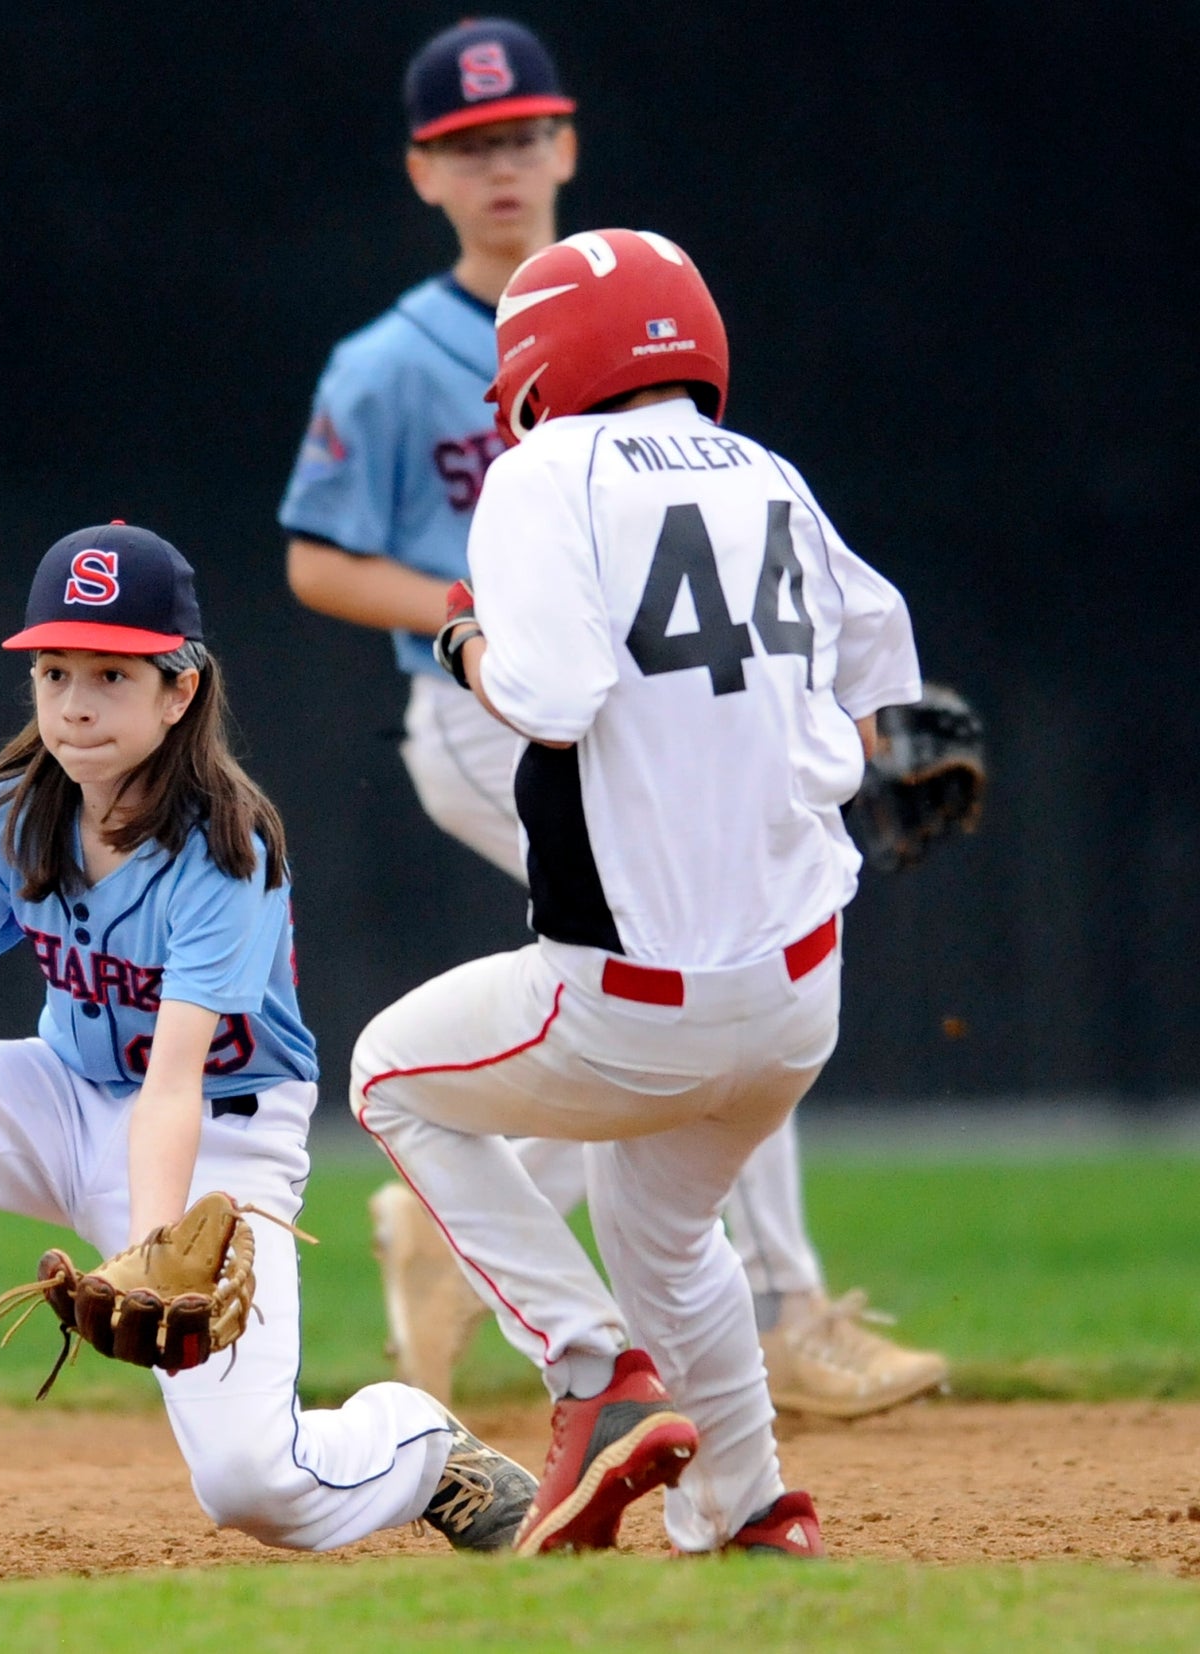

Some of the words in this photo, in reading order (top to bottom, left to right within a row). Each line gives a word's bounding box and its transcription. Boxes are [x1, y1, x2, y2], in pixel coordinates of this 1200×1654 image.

[459, 42, 513, 102] S
[613, 436, 752, 472] MILLER
[64, 549, 119, 606] S
[625, 500, 814, 696] 44
